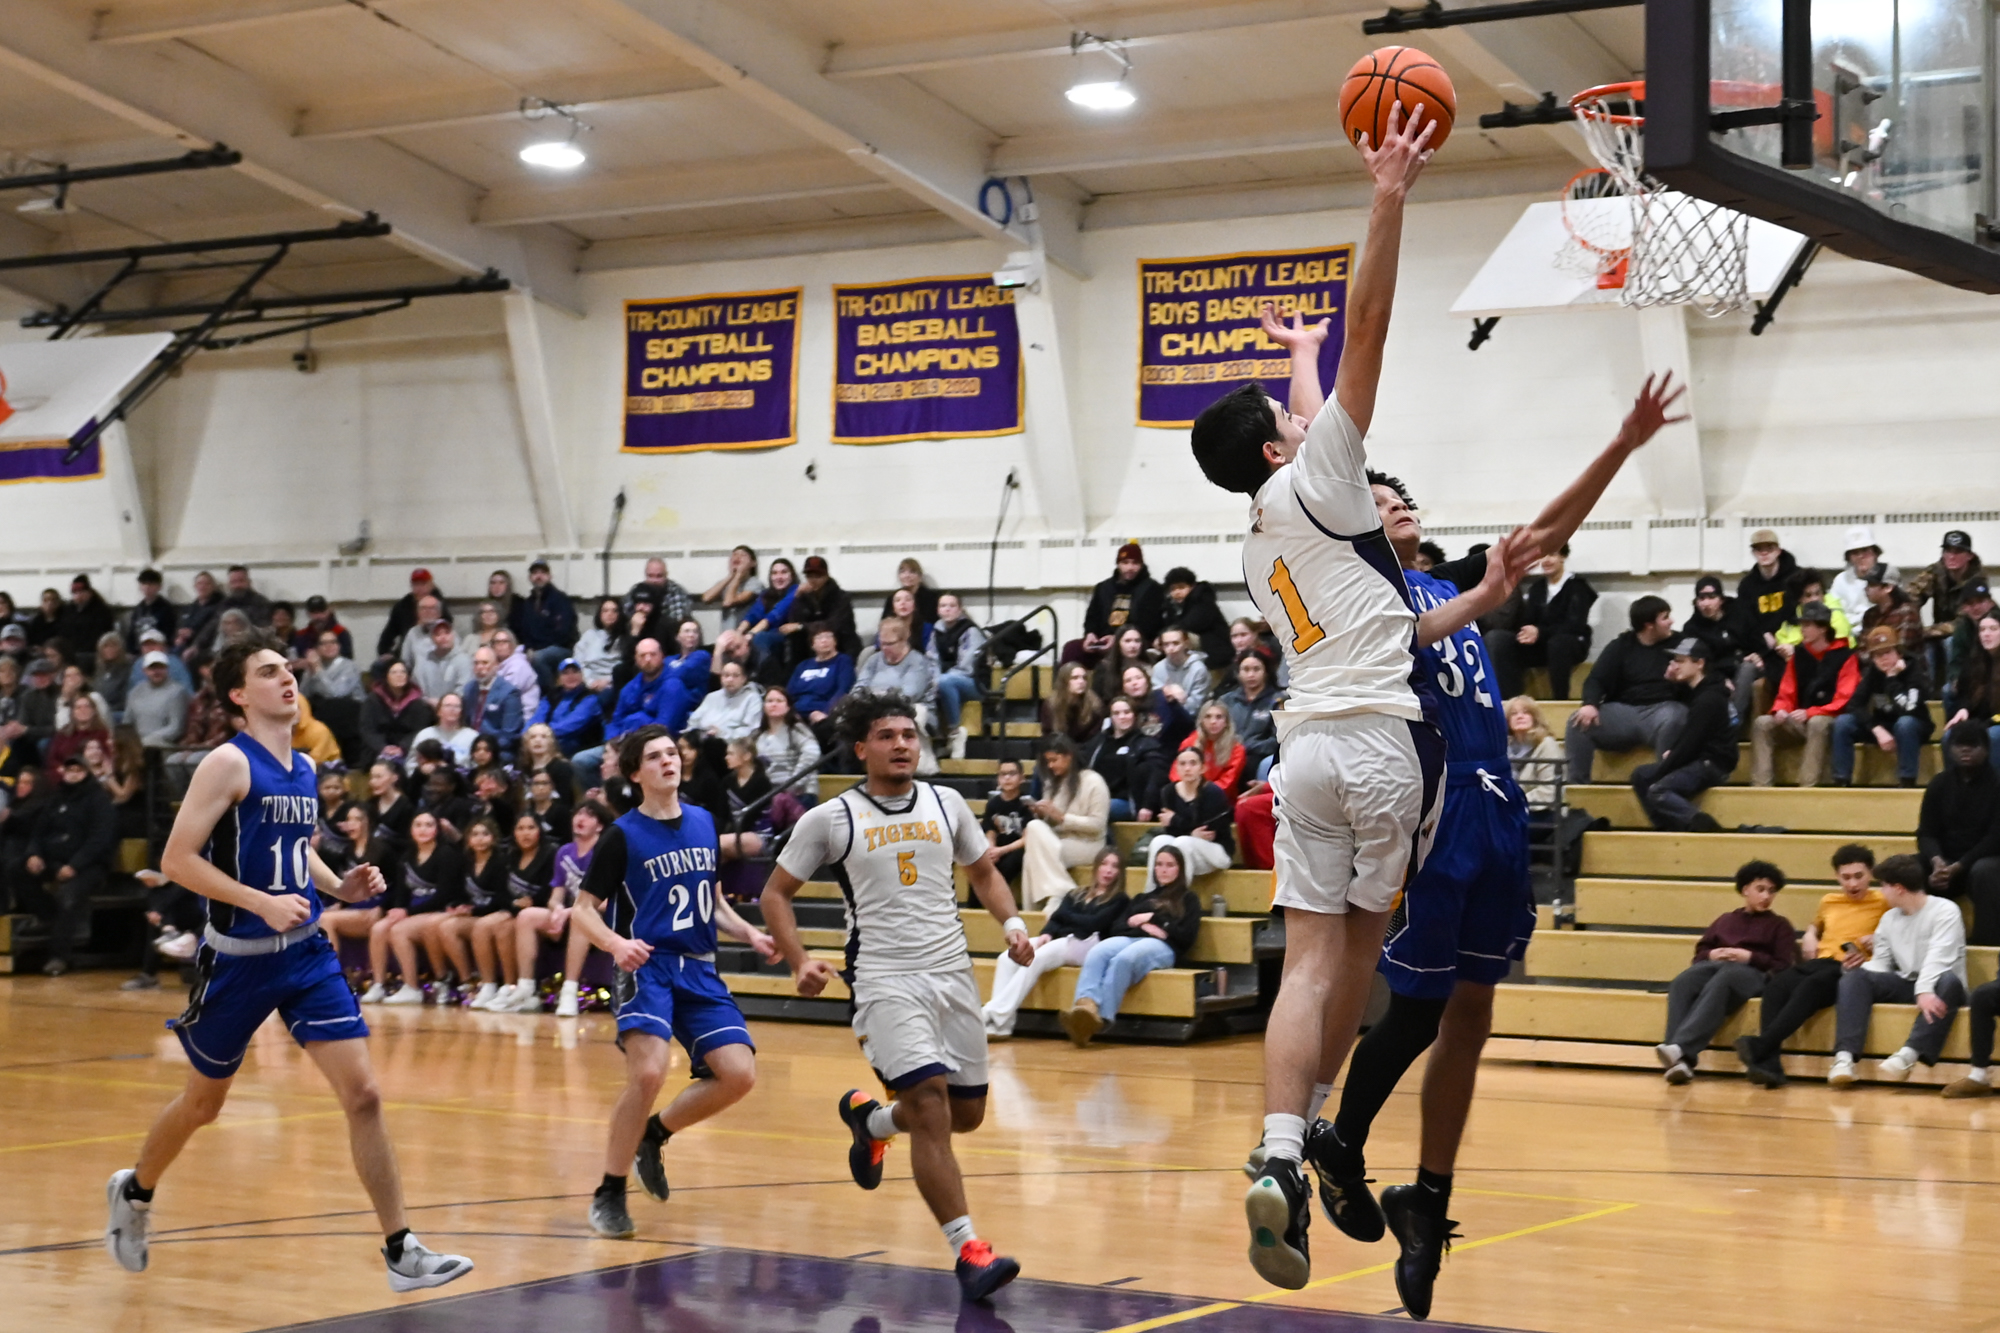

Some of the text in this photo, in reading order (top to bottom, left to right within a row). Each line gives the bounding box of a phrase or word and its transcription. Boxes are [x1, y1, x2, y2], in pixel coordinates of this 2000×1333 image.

[1145, 257, 1348, 294] TRI-COUNTY LEAGUE
[629, 299, 797, 332] TRI-COUNTY LEAGUE
[839, 289, 941, 317] TRI-COUNTY
[1149, 291, 1338, 325] BOYS BASKETBALL
[646, 331, 774, 360] SOFTBALL
[857, 316, 997, 346] BASEBALL
[641, 359, 773, 389] CHAMPIONS
[855, 345, 1000, 376] CHAMPIONS
[1183, 365, 1216, 381] 2018
[1222, 361, 1254, 377] 2020
[1268, 554, 1326, 654] 1
[1432, 636, 1494, 709] 32
[864, 820, 942, 852] TIGERS
[268, 836, 310, 890] 10
[897, 850, 918, 886] 5
[668, 879, 714, 931] 20
